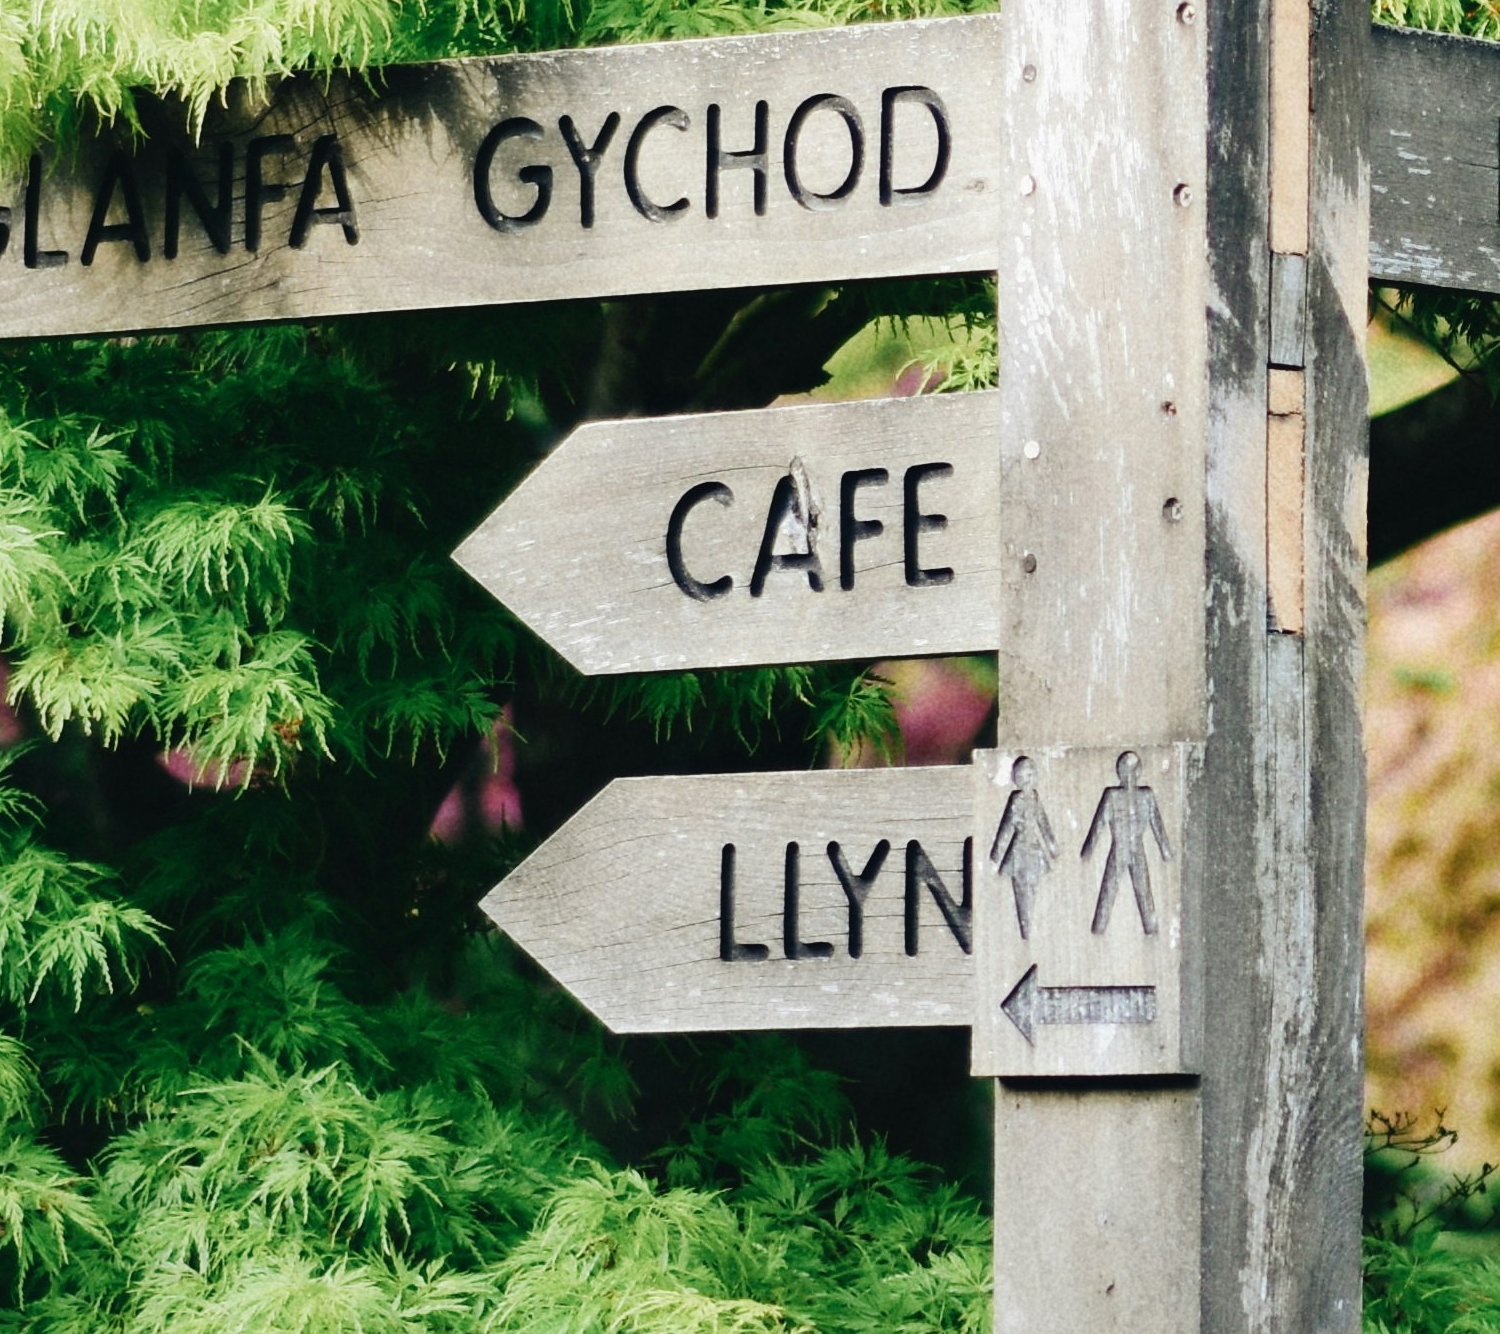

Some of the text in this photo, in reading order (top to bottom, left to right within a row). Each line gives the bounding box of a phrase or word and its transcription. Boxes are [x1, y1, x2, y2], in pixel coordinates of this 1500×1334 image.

[471, 83, 954, 235] GYCHOD
[665, 461, 956, 603] CAFE
[718, 837, 974, 963] LLYN
